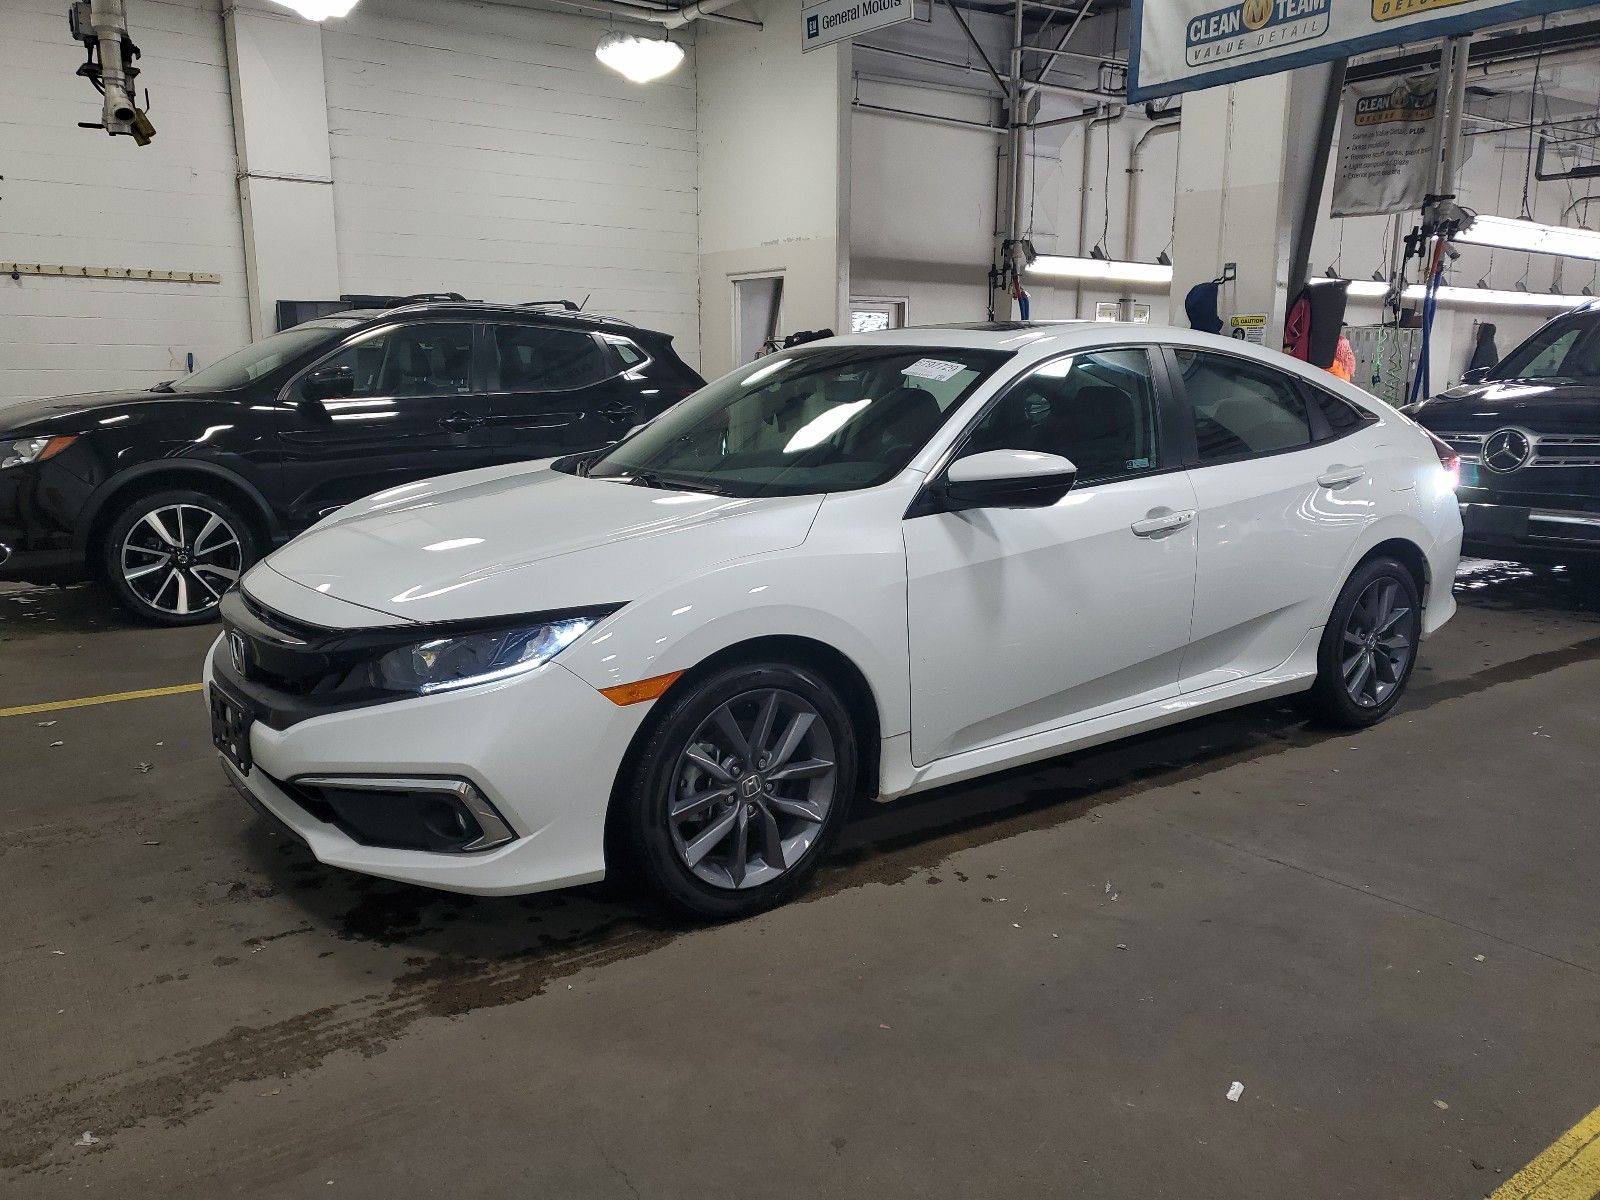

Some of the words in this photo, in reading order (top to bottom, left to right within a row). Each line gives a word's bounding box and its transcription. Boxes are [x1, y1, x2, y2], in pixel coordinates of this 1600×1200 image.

[821, 5, 860, 28] General
[862, 0, 903, 16] Motors
[1190, 10, 1240, 41] CLEAN
[1194, 39, 1245, 60] VALUE
[1257, 21, 1318, 46] DETAIL
[1358, 96, 1390, 111] CLEAN
